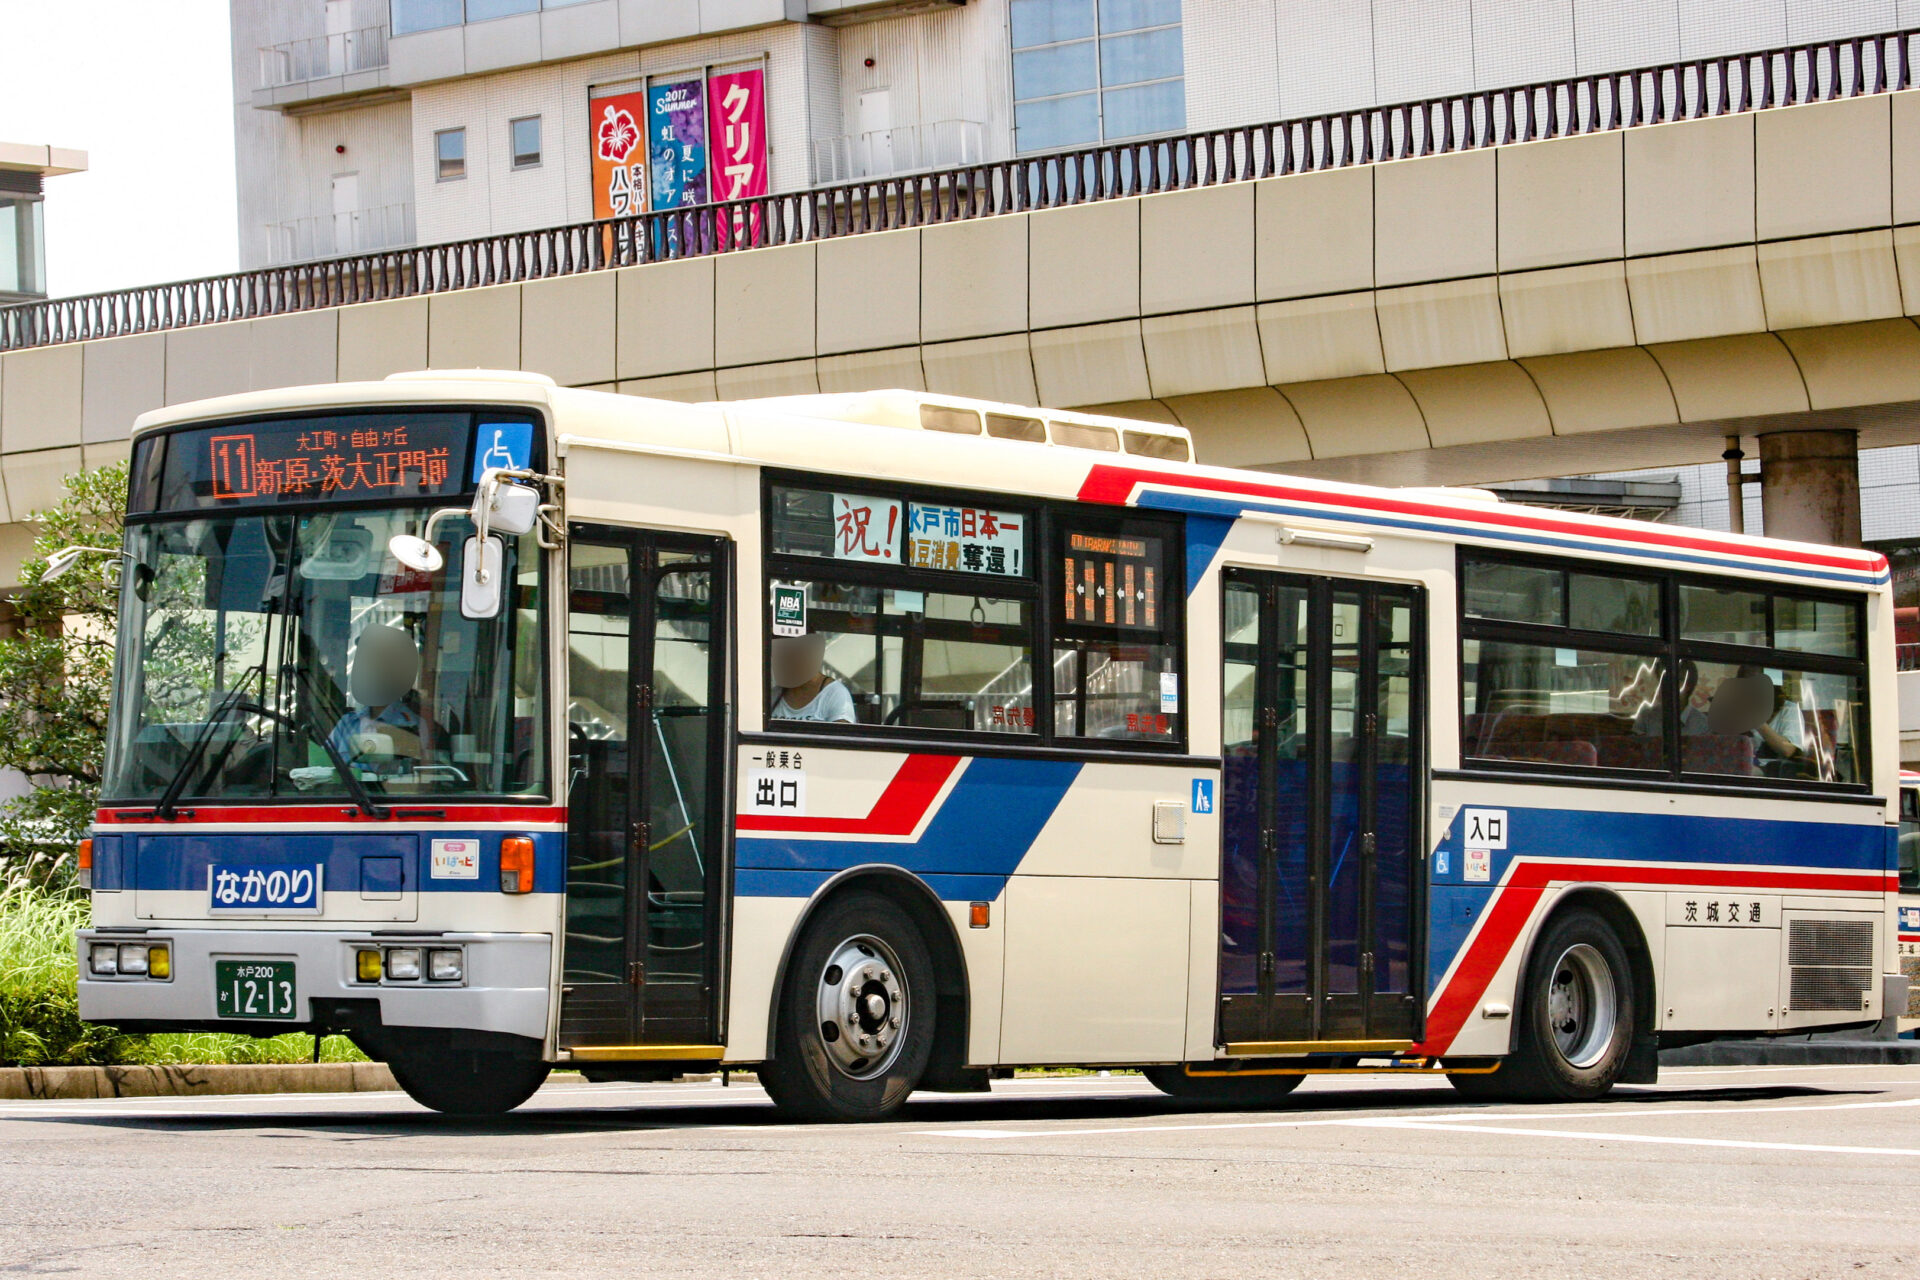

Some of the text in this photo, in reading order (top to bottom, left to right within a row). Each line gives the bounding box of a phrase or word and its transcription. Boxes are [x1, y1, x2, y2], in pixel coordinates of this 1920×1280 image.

[655, 97, 698, 115] Summer
[665, 89, 688, 103] 2017
[218, 443, 249, 491] 11
[256, 447, 450, 495] 新原・茨大正門前
[836, 498, 899, 558] 祝!
[780, 596, 800, 609] NBA
[752, 750, 802, 769] 一般乗合
[756, 777, 797, 808] 出口
[1470, 816, 1501, 842] 入口
[216, 869, 313, 904] なかのり
[1685, 901, 1761, 922] 茨城交通
[237, 966, 273, 978] 水戸200
[234, 980, 292, 1014] 12-13
